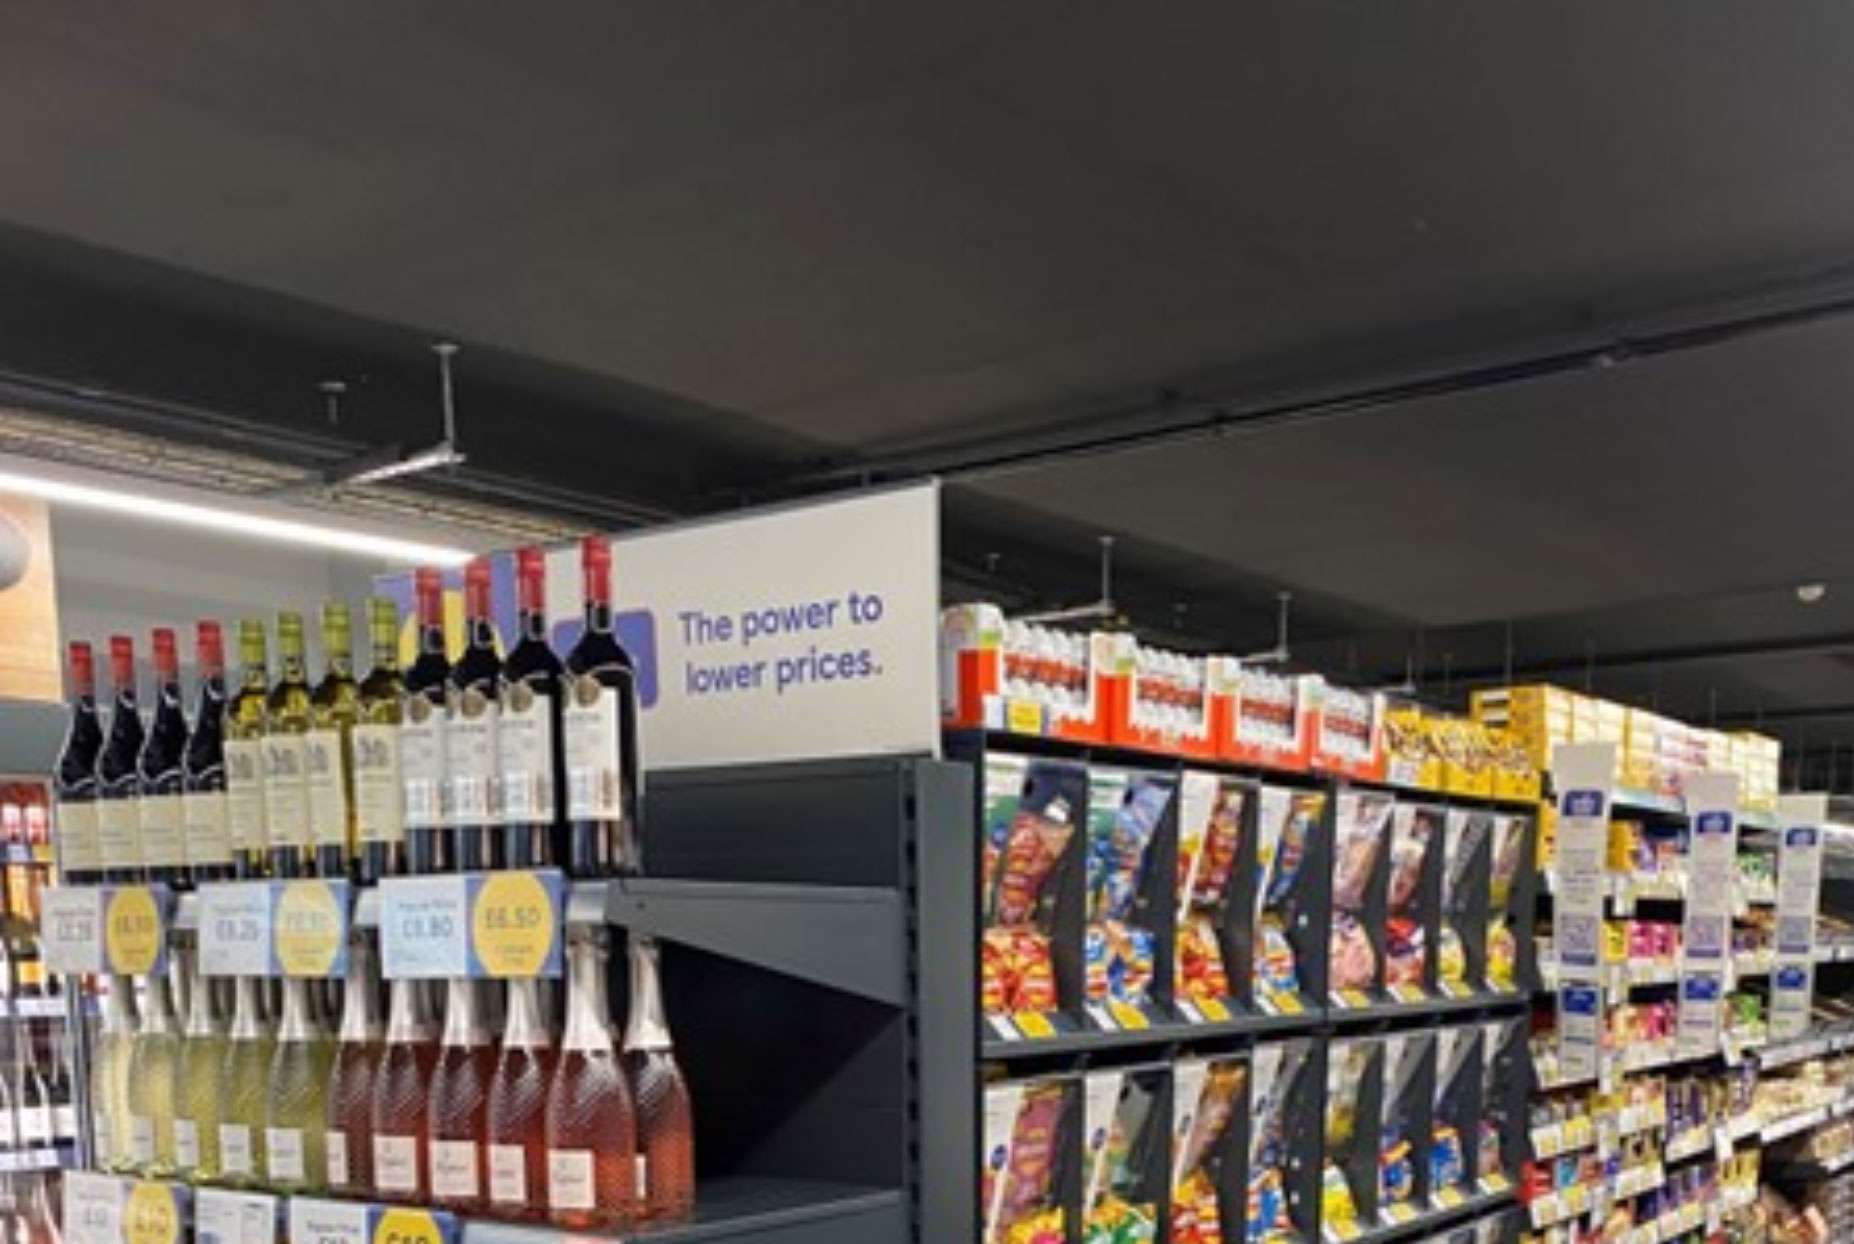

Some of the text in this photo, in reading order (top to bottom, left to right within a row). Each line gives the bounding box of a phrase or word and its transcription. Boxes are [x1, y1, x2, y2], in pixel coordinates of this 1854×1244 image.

[680, 591, 883, 646] The power to
[687, 647, 884, 694] lower prices.
